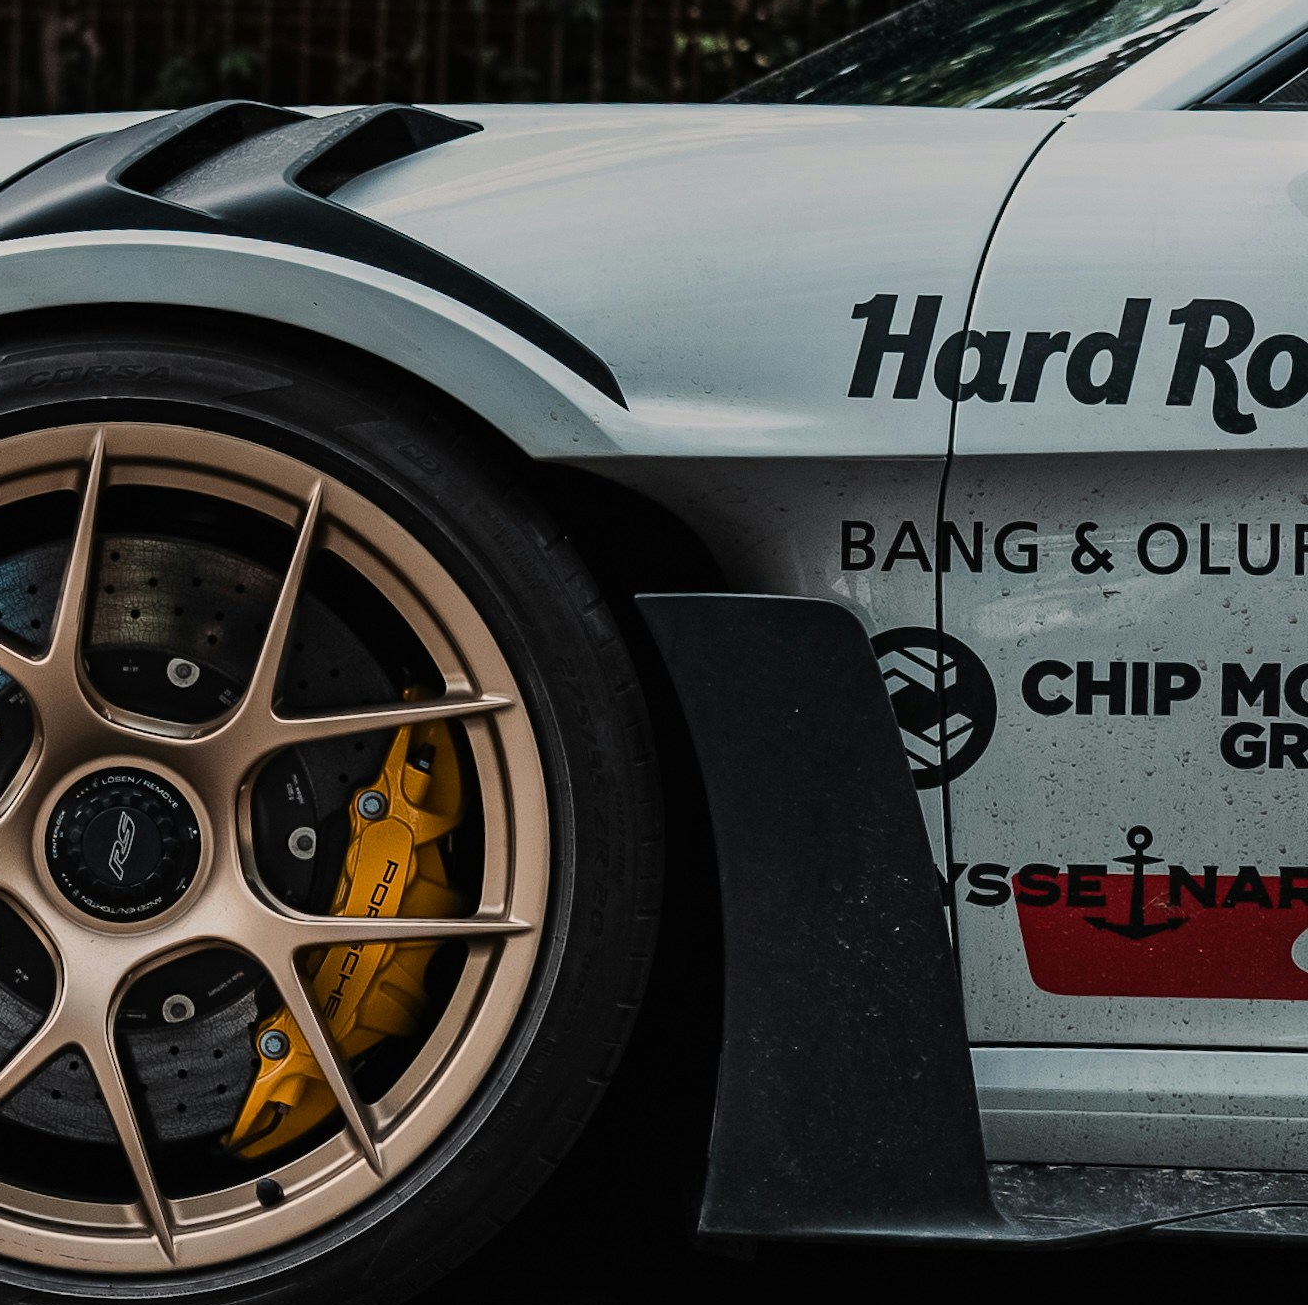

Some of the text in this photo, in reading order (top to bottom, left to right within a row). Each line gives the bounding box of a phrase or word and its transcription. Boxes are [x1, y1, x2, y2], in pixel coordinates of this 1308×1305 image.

[25, 365, 172, 390] CORSA
[848, 294, 1152, 406] Hard
[840, 520, 1040, 575] BANG
[1070, 521, 1116, 576] &
[1021, 659, 1202, 717] CHIP
